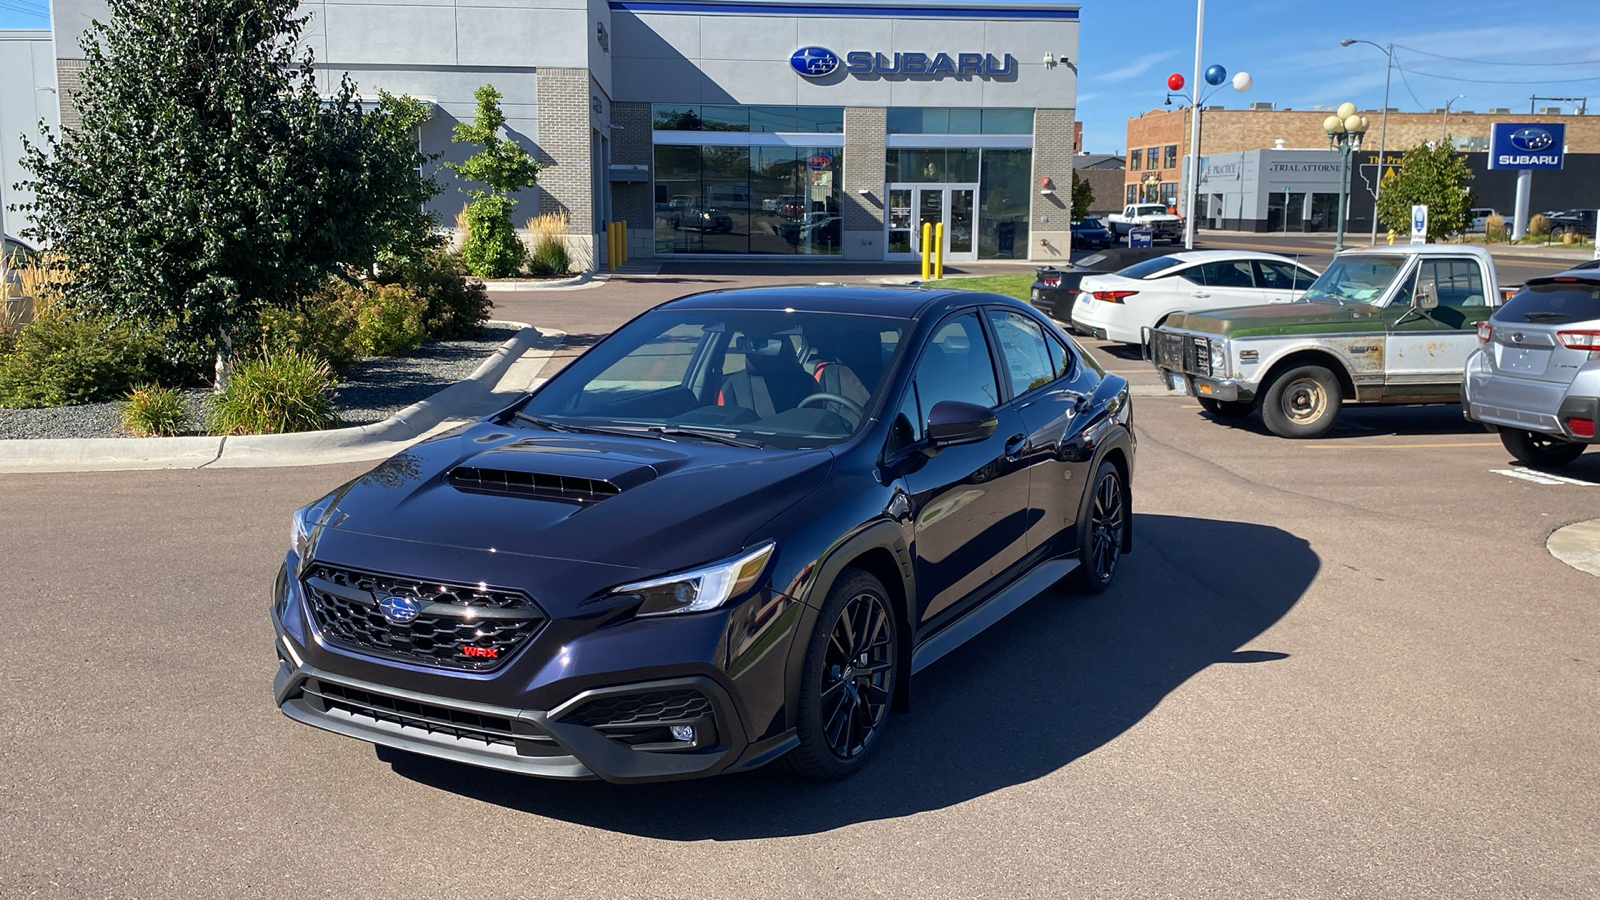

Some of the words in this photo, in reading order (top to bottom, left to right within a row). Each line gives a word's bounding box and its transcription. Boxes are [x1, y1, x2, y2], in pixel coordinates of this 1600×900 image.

[847, 51, 1011, 75] SUBARU
[1498, 155, 1558, 165] SUBARU
[1213, 164, 1236, 174] PRACTICE
[1273, 164, 1300, 172] TRIAL
[1301, 164, 1351, 172] ATTORNES
[463, 646, 499, 658] WRX
